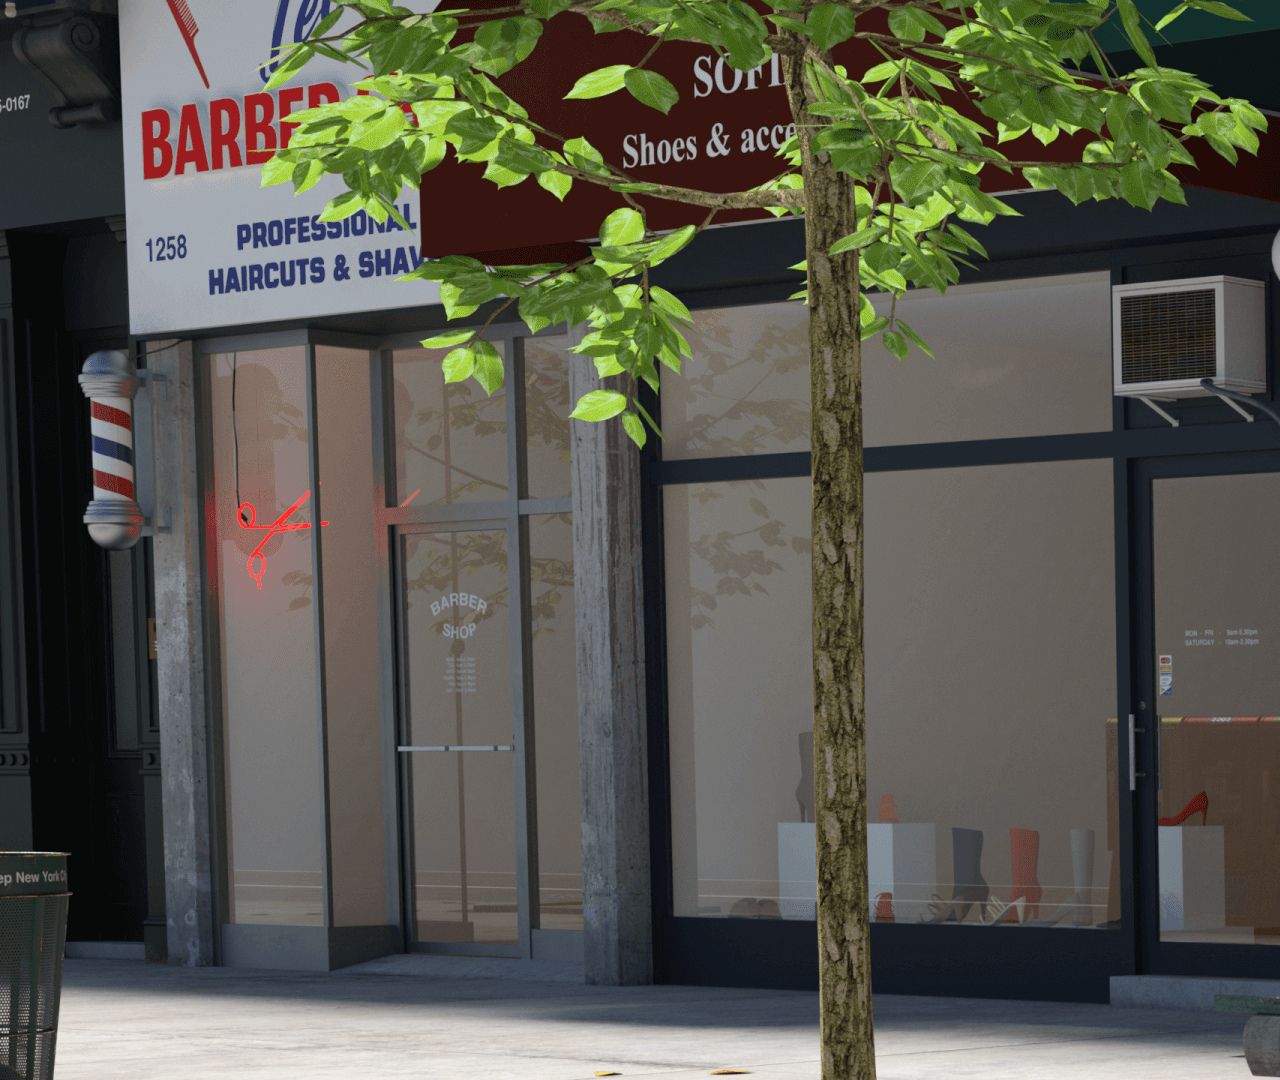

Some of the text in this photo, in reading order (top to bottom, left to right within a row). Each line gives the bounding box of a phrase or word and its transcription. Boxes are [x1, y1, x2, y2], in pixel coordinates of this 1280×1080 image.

[694, 52, 788, 98] SOFI
[623, 122, 798, 169] Shoes & acce
[236, 203, 417, 251] PROFESSIONAL
[145, 234, 188, 262] 1258
[208, 245, 432, 295] HAIRCUTS & SHAV
[430, 592, 488, 617] BARBER
[442, 622, 477, 640] SHOP
[15, 871, 40, 884] New
[42, 870, 60, 882] York
